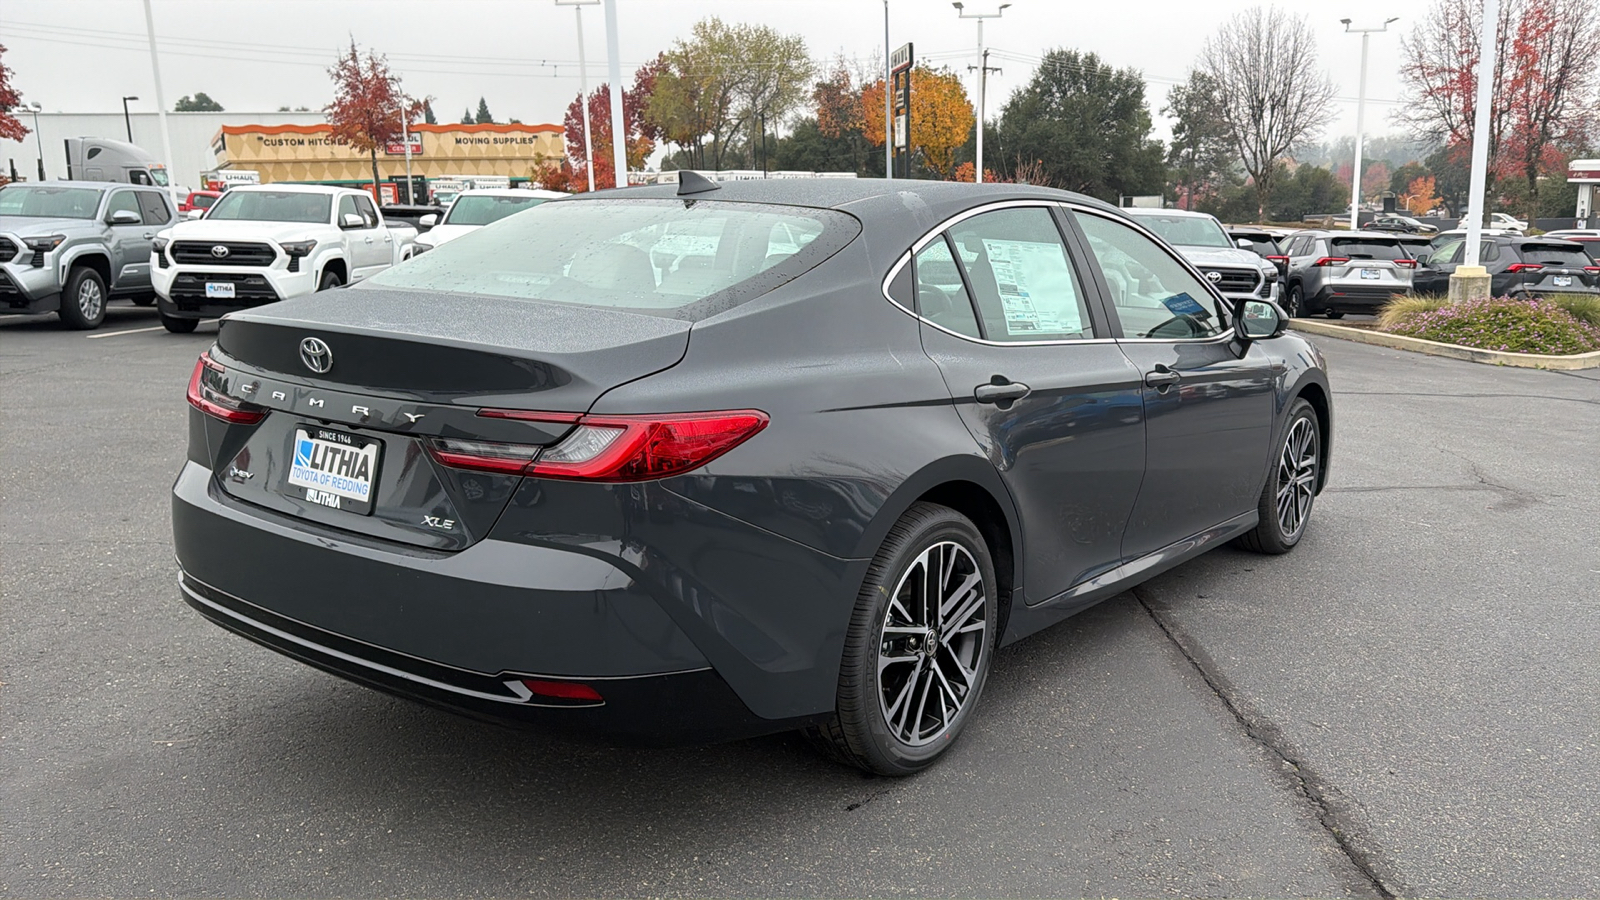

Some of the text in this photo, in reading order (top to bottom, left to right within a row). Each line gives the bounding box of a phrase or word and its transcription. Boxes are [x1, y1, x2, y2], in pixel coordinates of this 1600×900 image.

[455, 137, 490, 145] MOVING
[241, 384, 425, 423] CAMRY
[318, 430, 351, 444] SINCE 1946
[310, 443, 369, 482] LITHIA
[293, 466, 369, 495] TOYOTA OF REDDING
[314, 490, 341, 509] LITHIA
[420, 514, 455, 530] XLE
